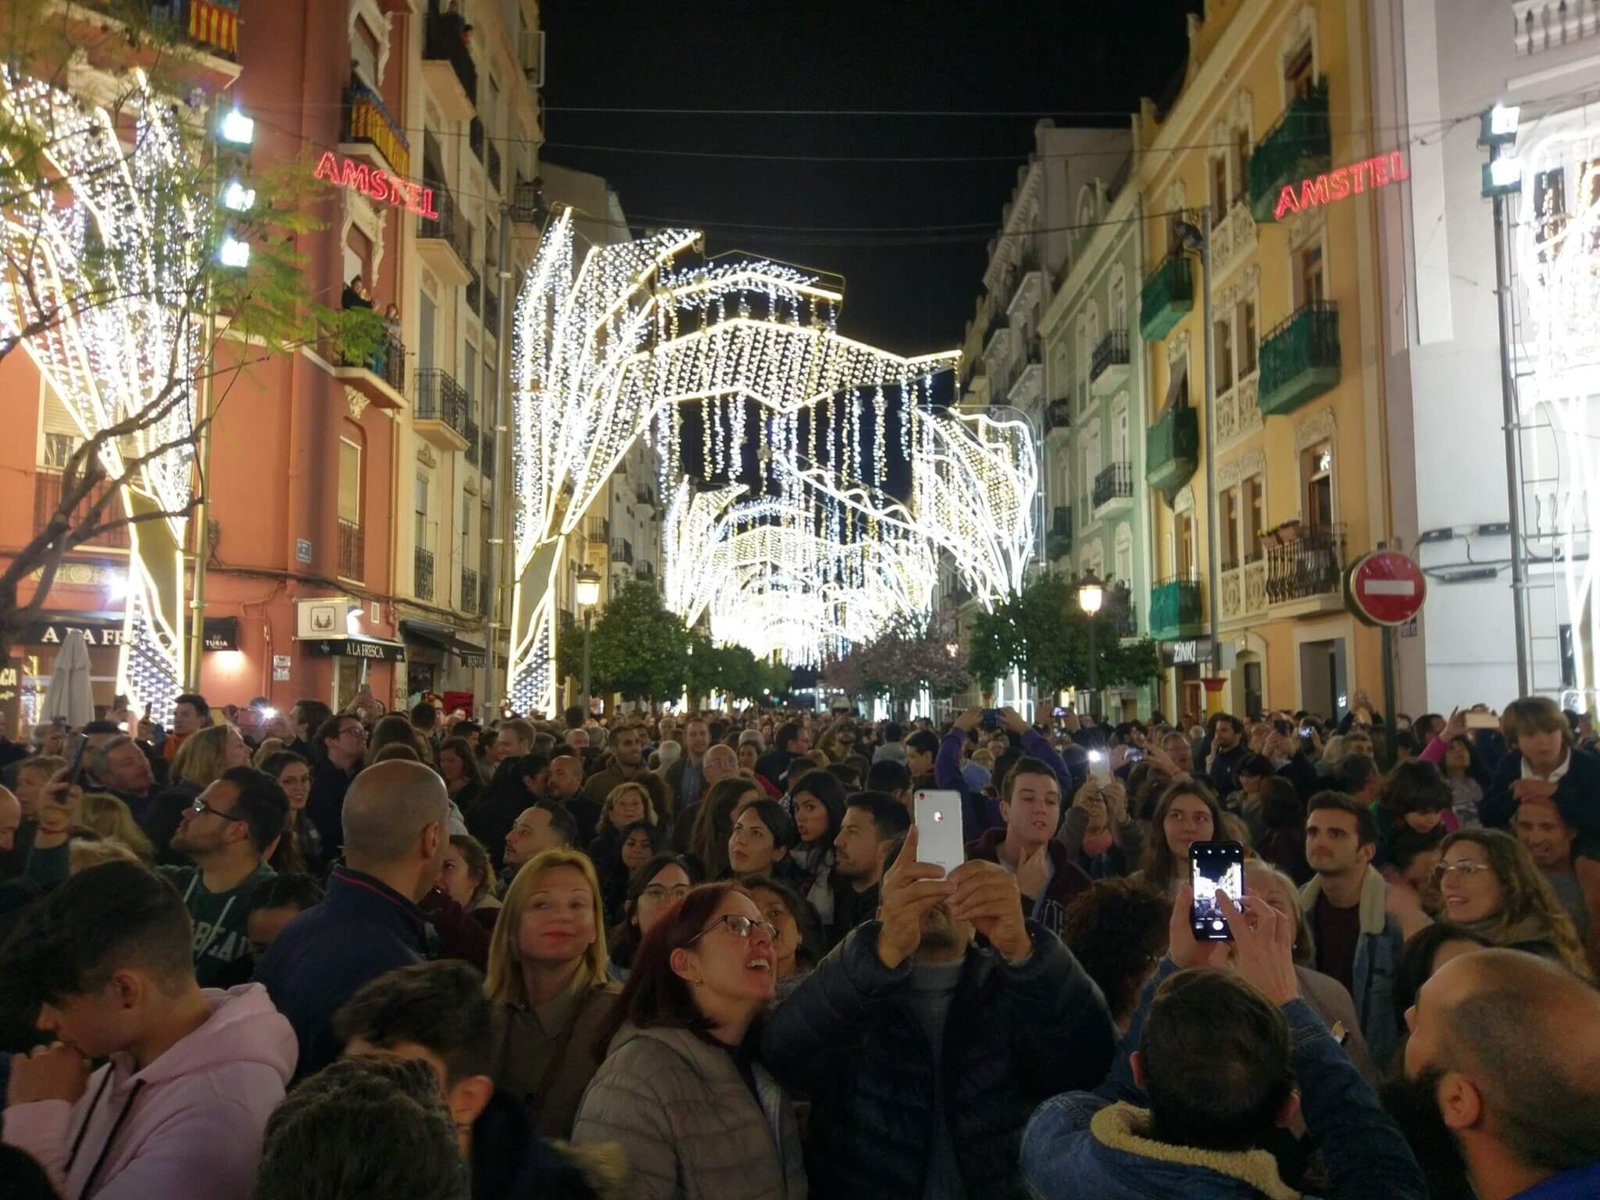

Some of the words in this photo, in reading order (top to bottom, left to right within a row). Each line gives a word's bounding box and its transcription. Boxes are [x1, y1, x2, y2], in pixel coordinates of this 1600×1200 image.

[313, 151, 439, 220] AMSTEL
[1274, 150, 1410, 219] AMSTEL
[42, 627, 60, 643] A
[352, 643, 362, 656] LA
[362, 644, 385, 659] FRESCA
